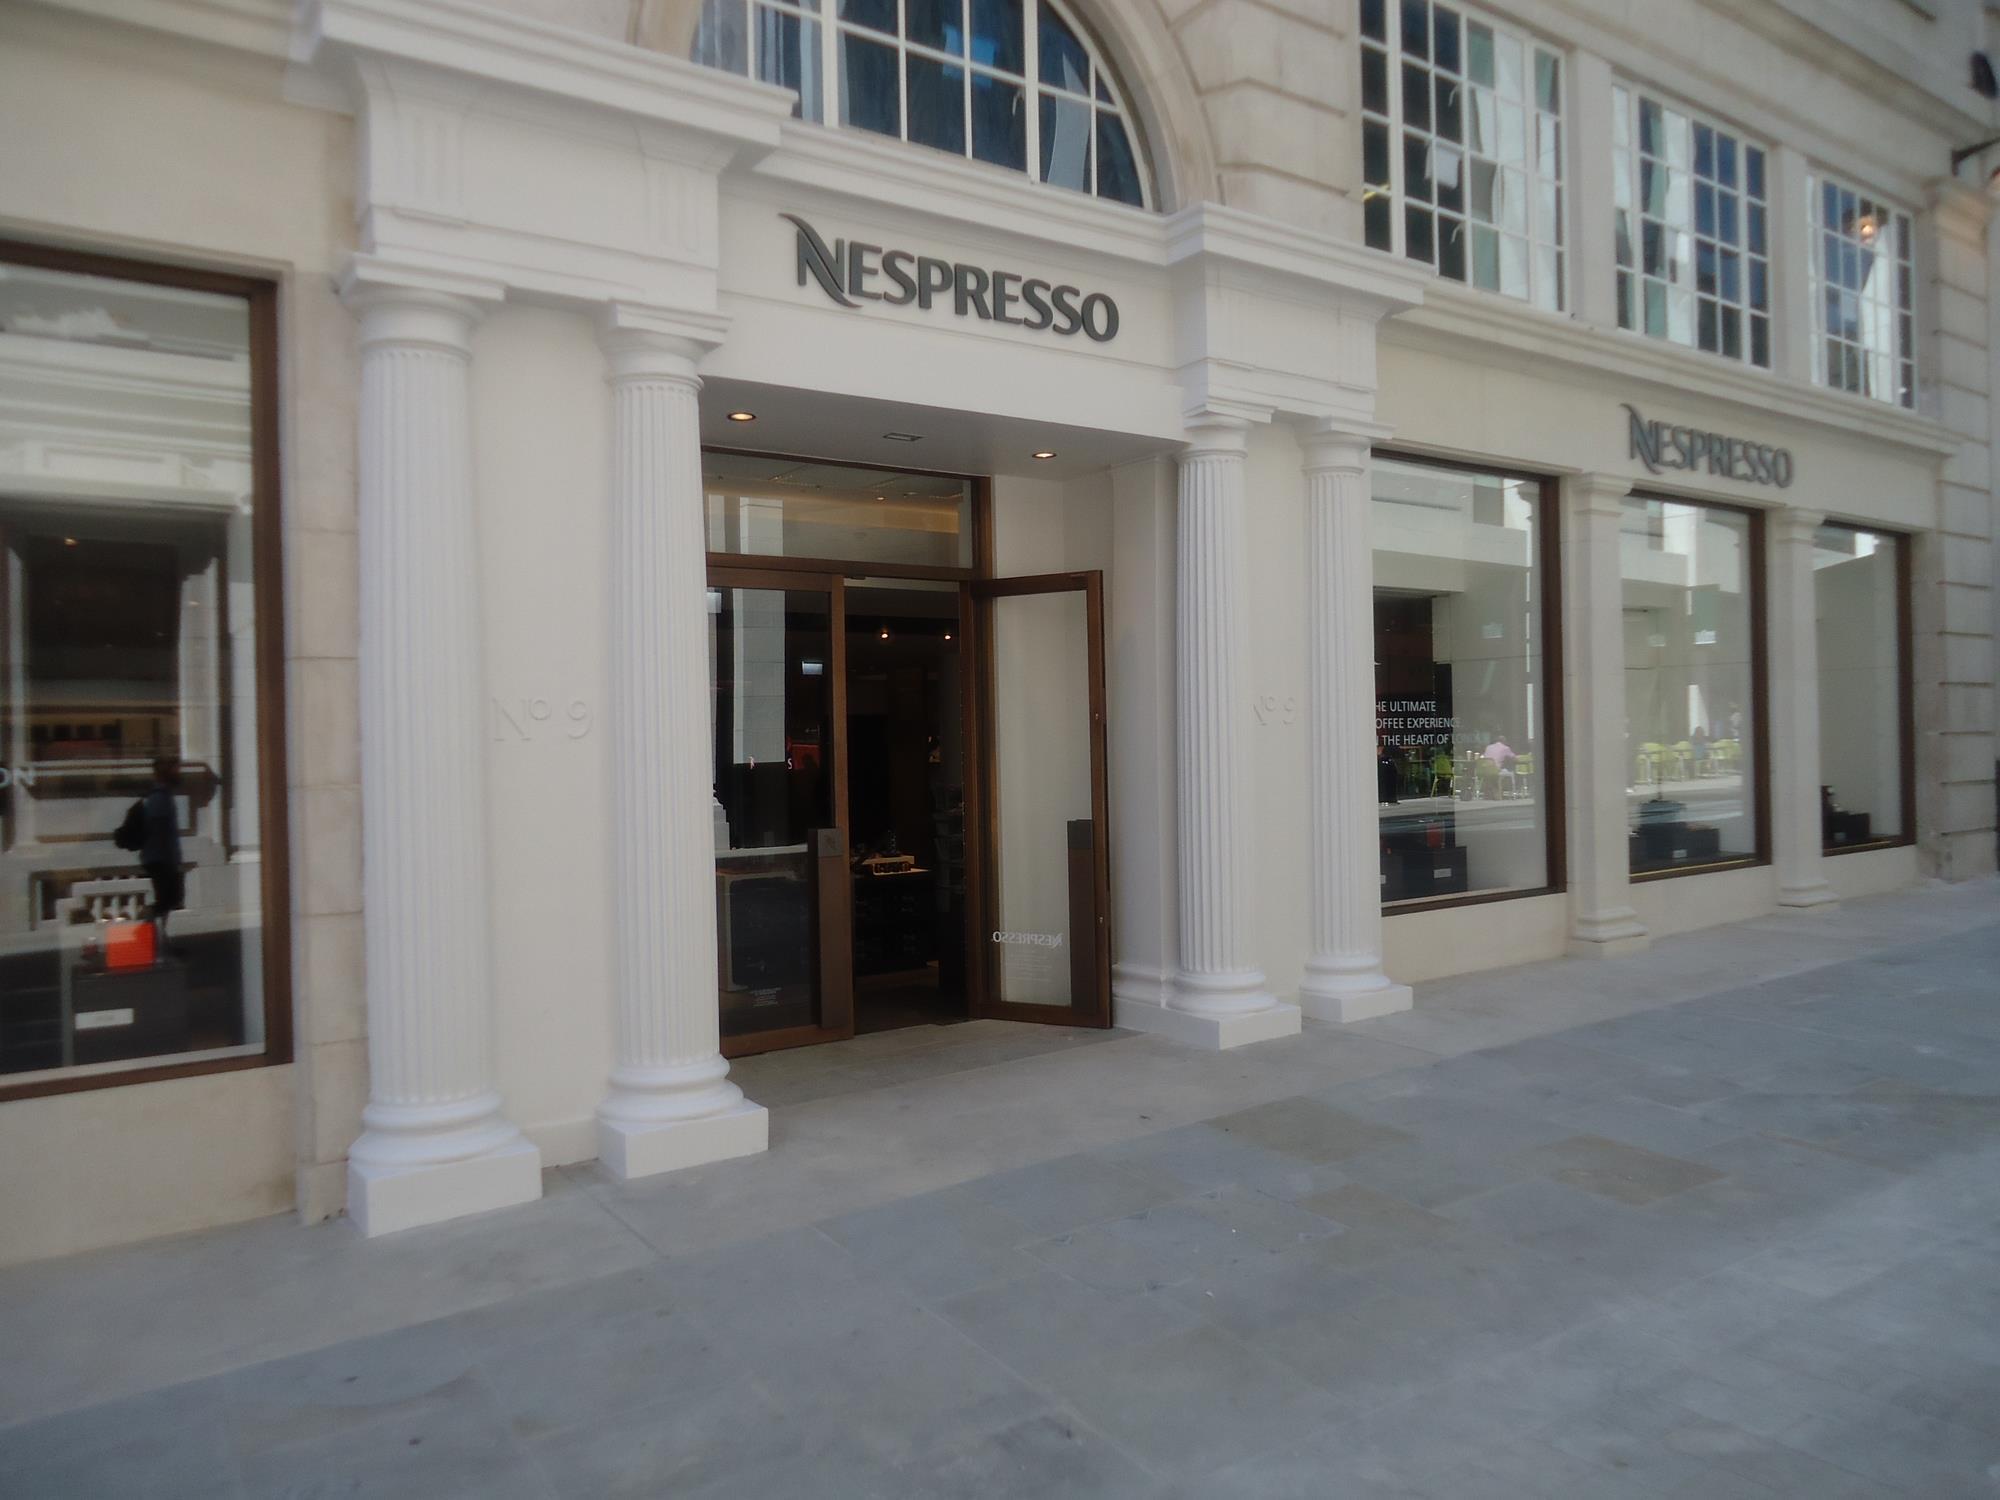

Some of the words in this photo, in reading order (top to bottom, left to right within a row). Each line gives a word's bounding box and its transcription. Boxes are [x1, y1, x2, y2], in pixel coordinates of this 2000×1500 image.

[778, 212, 1120, 342] NESPRESSO
[1619, 402, 1796, 489] NESPRESSO
[1389, 700, 1437, 712] ULTIMATE
[1375, 717, 1404, 729] OFFEE
[1382, 735, 1401, 746] THE
[1403, 734, 1435, 745] HEART
[1436, 733, 1449, 744] OF
